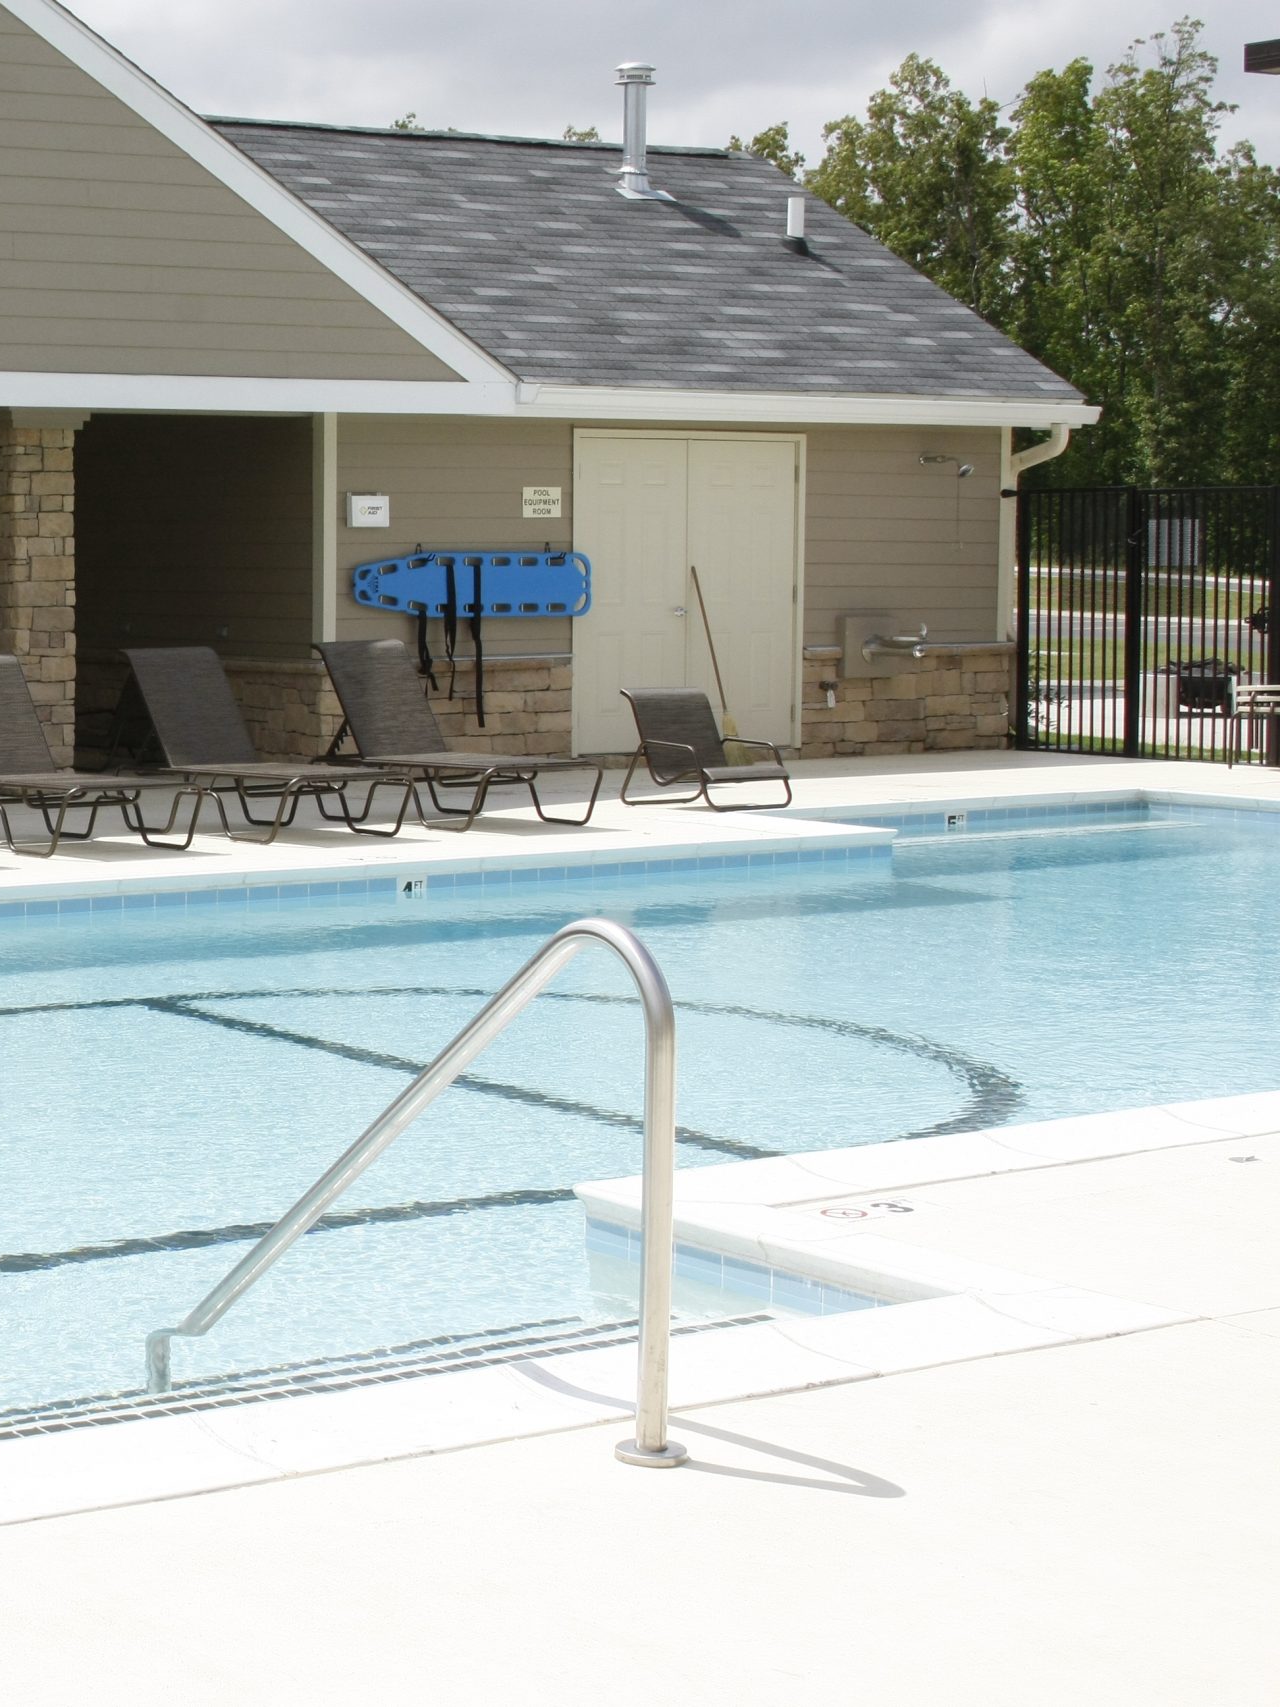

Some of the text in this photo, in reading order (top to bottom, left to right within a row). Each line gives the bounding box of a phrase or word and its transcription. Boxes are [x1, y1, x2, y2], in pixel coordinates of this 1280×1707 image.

[524, 498, 560, 506] EQUIPMENT
[414, 880, 423, 889] FT
[870, 1202, 914, 1213] 3
